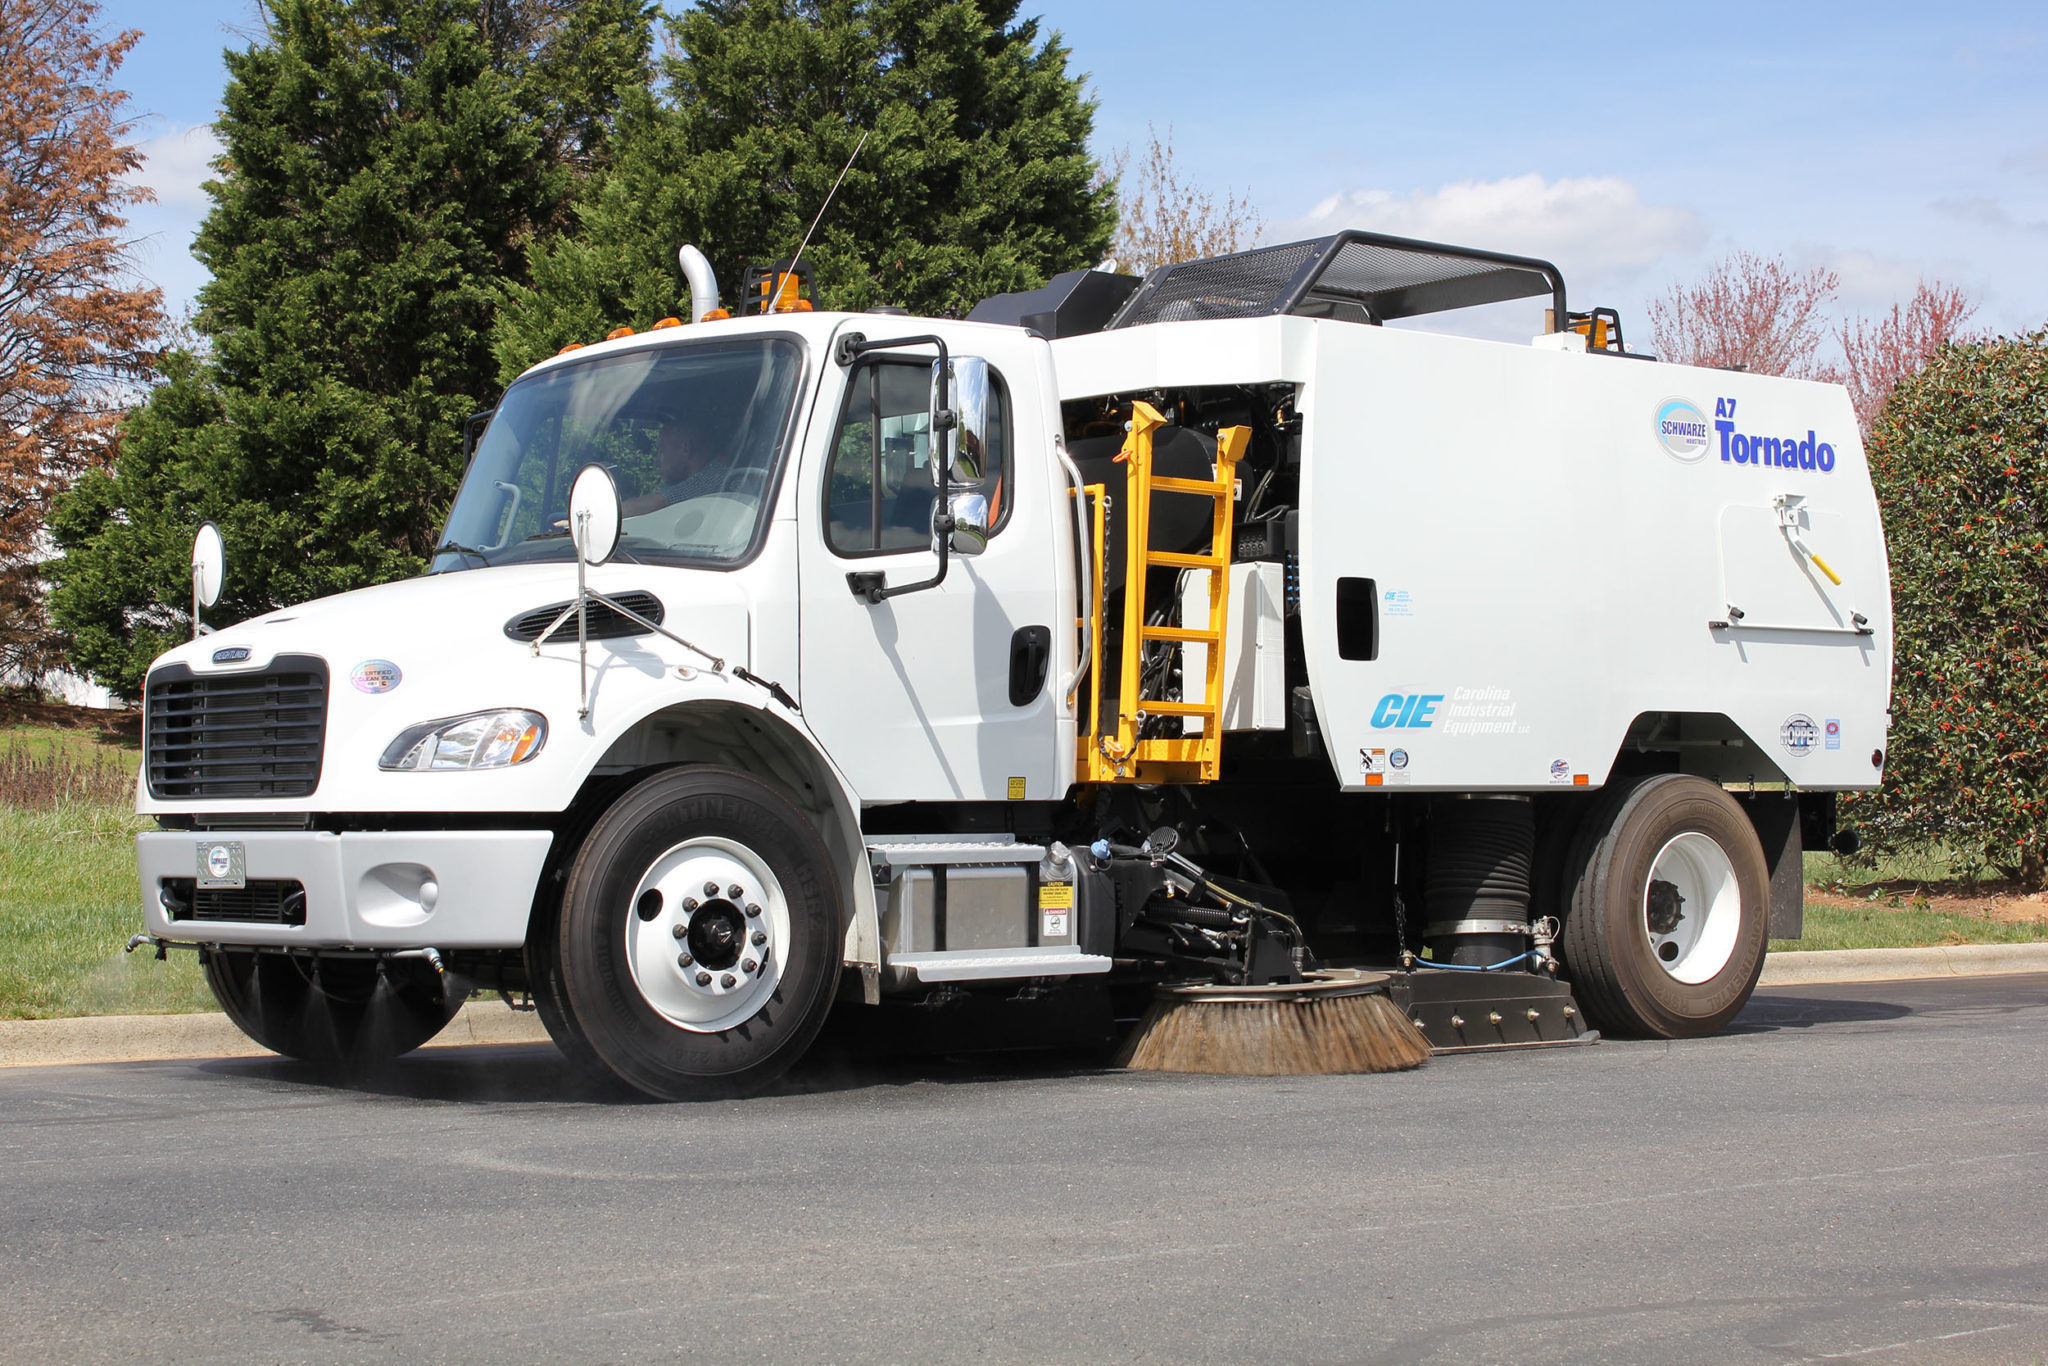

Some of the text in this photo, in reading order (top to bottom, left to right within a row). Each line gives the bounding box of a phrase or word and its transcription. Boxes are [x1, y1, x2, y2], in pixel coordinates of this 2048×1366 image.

[1715, 397, 1736, 418] A7
[1661, 420, 1706, 438] SCHWARZE
[1715, 420, 1835, 472] Tornado
[1453, 685, 1511, 701] Carolina
[1370, 693, 1445, 729] CIE
[1448, 702, 1517, 718] Industrial
[1442, 719, 1517, 737] Equipment
[1780, 726, 1820, 746] HOPPER
